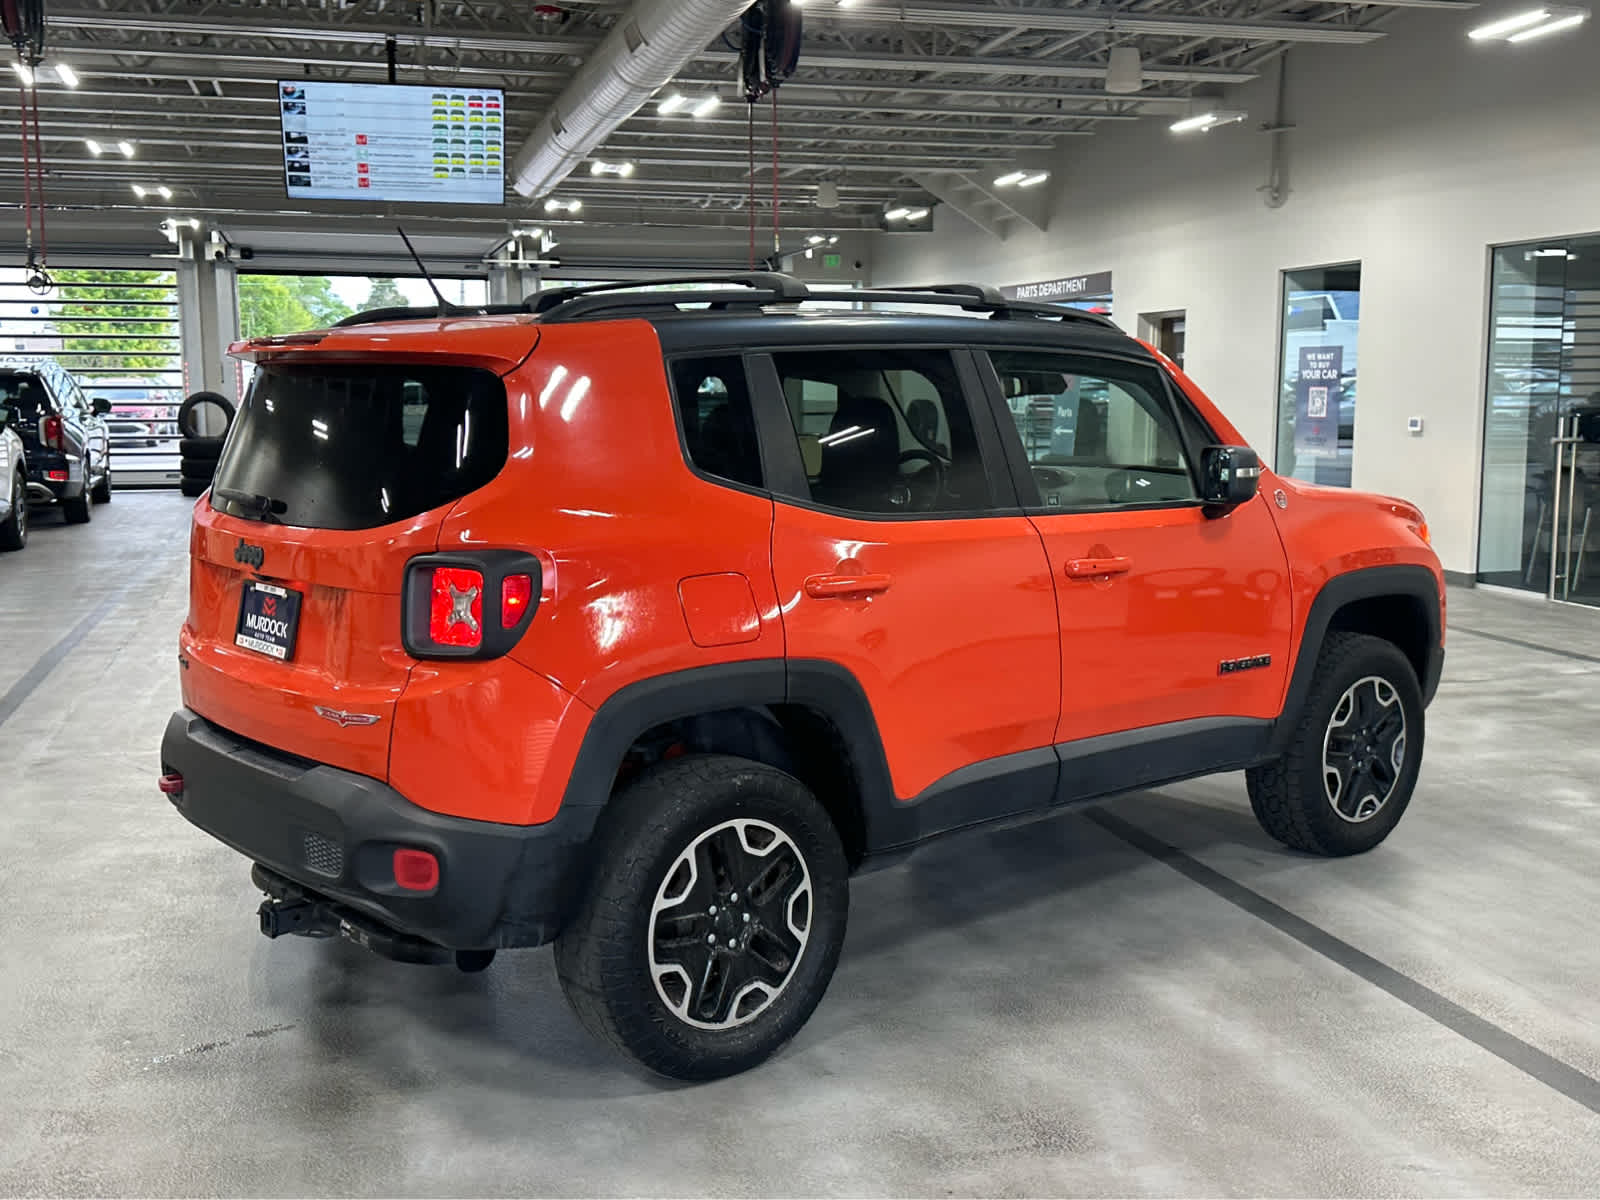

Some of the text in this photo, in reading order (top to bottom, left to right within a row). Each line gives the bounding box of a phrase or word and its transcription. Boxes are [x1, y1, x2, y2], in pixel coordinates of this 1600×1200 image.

[1016, 278, 1087, 299] PARTS DEPARTMENT
[1306, 352, 1335, 361] WE WANT
[1310, 361, 1330, 369] TO BUY
[1302, 369, 1338, 380] YOUR CAR
[1058, 406, 1073, 417] Parts
[235, 538, 265, 571] Jeep
[246, 613, 288, 639] MURDOCK
